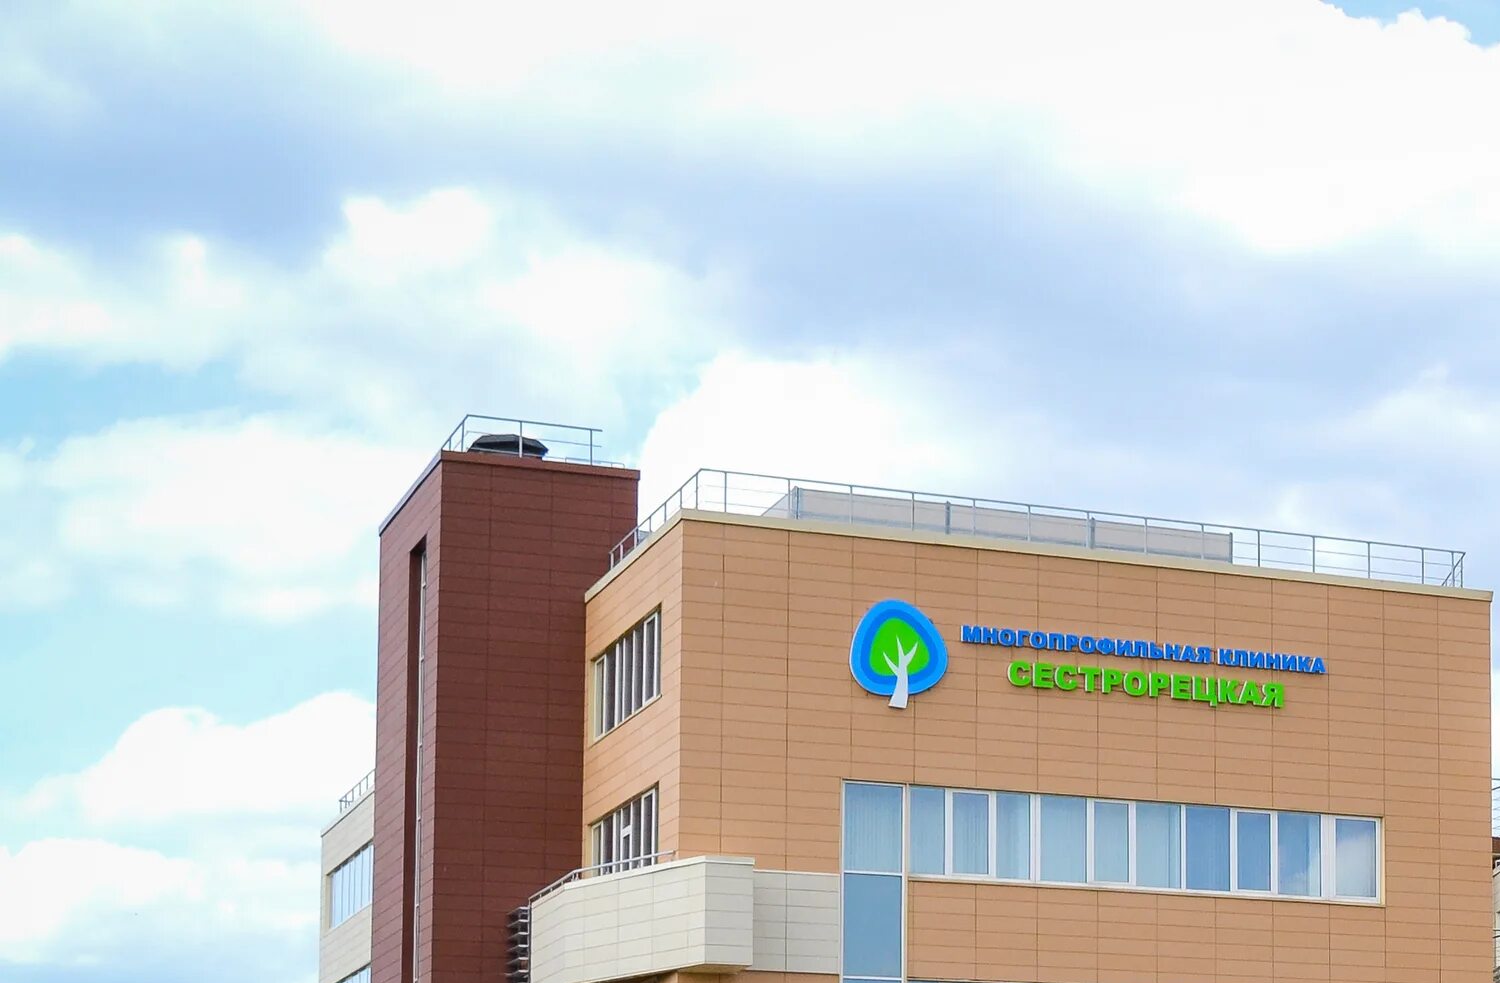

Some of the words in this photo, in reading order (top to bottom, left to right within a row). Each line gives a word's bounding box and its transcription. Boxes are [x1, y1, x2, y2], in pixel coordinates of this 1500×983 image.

[960, 625, 1211, 664] МНОГОПРОФИЛЬНАЯ
[1217, 648, 1326, 674] КЛИНИКА
[1008, 660, 1285, 707] СЕСТРОРЕЦКАЯ
